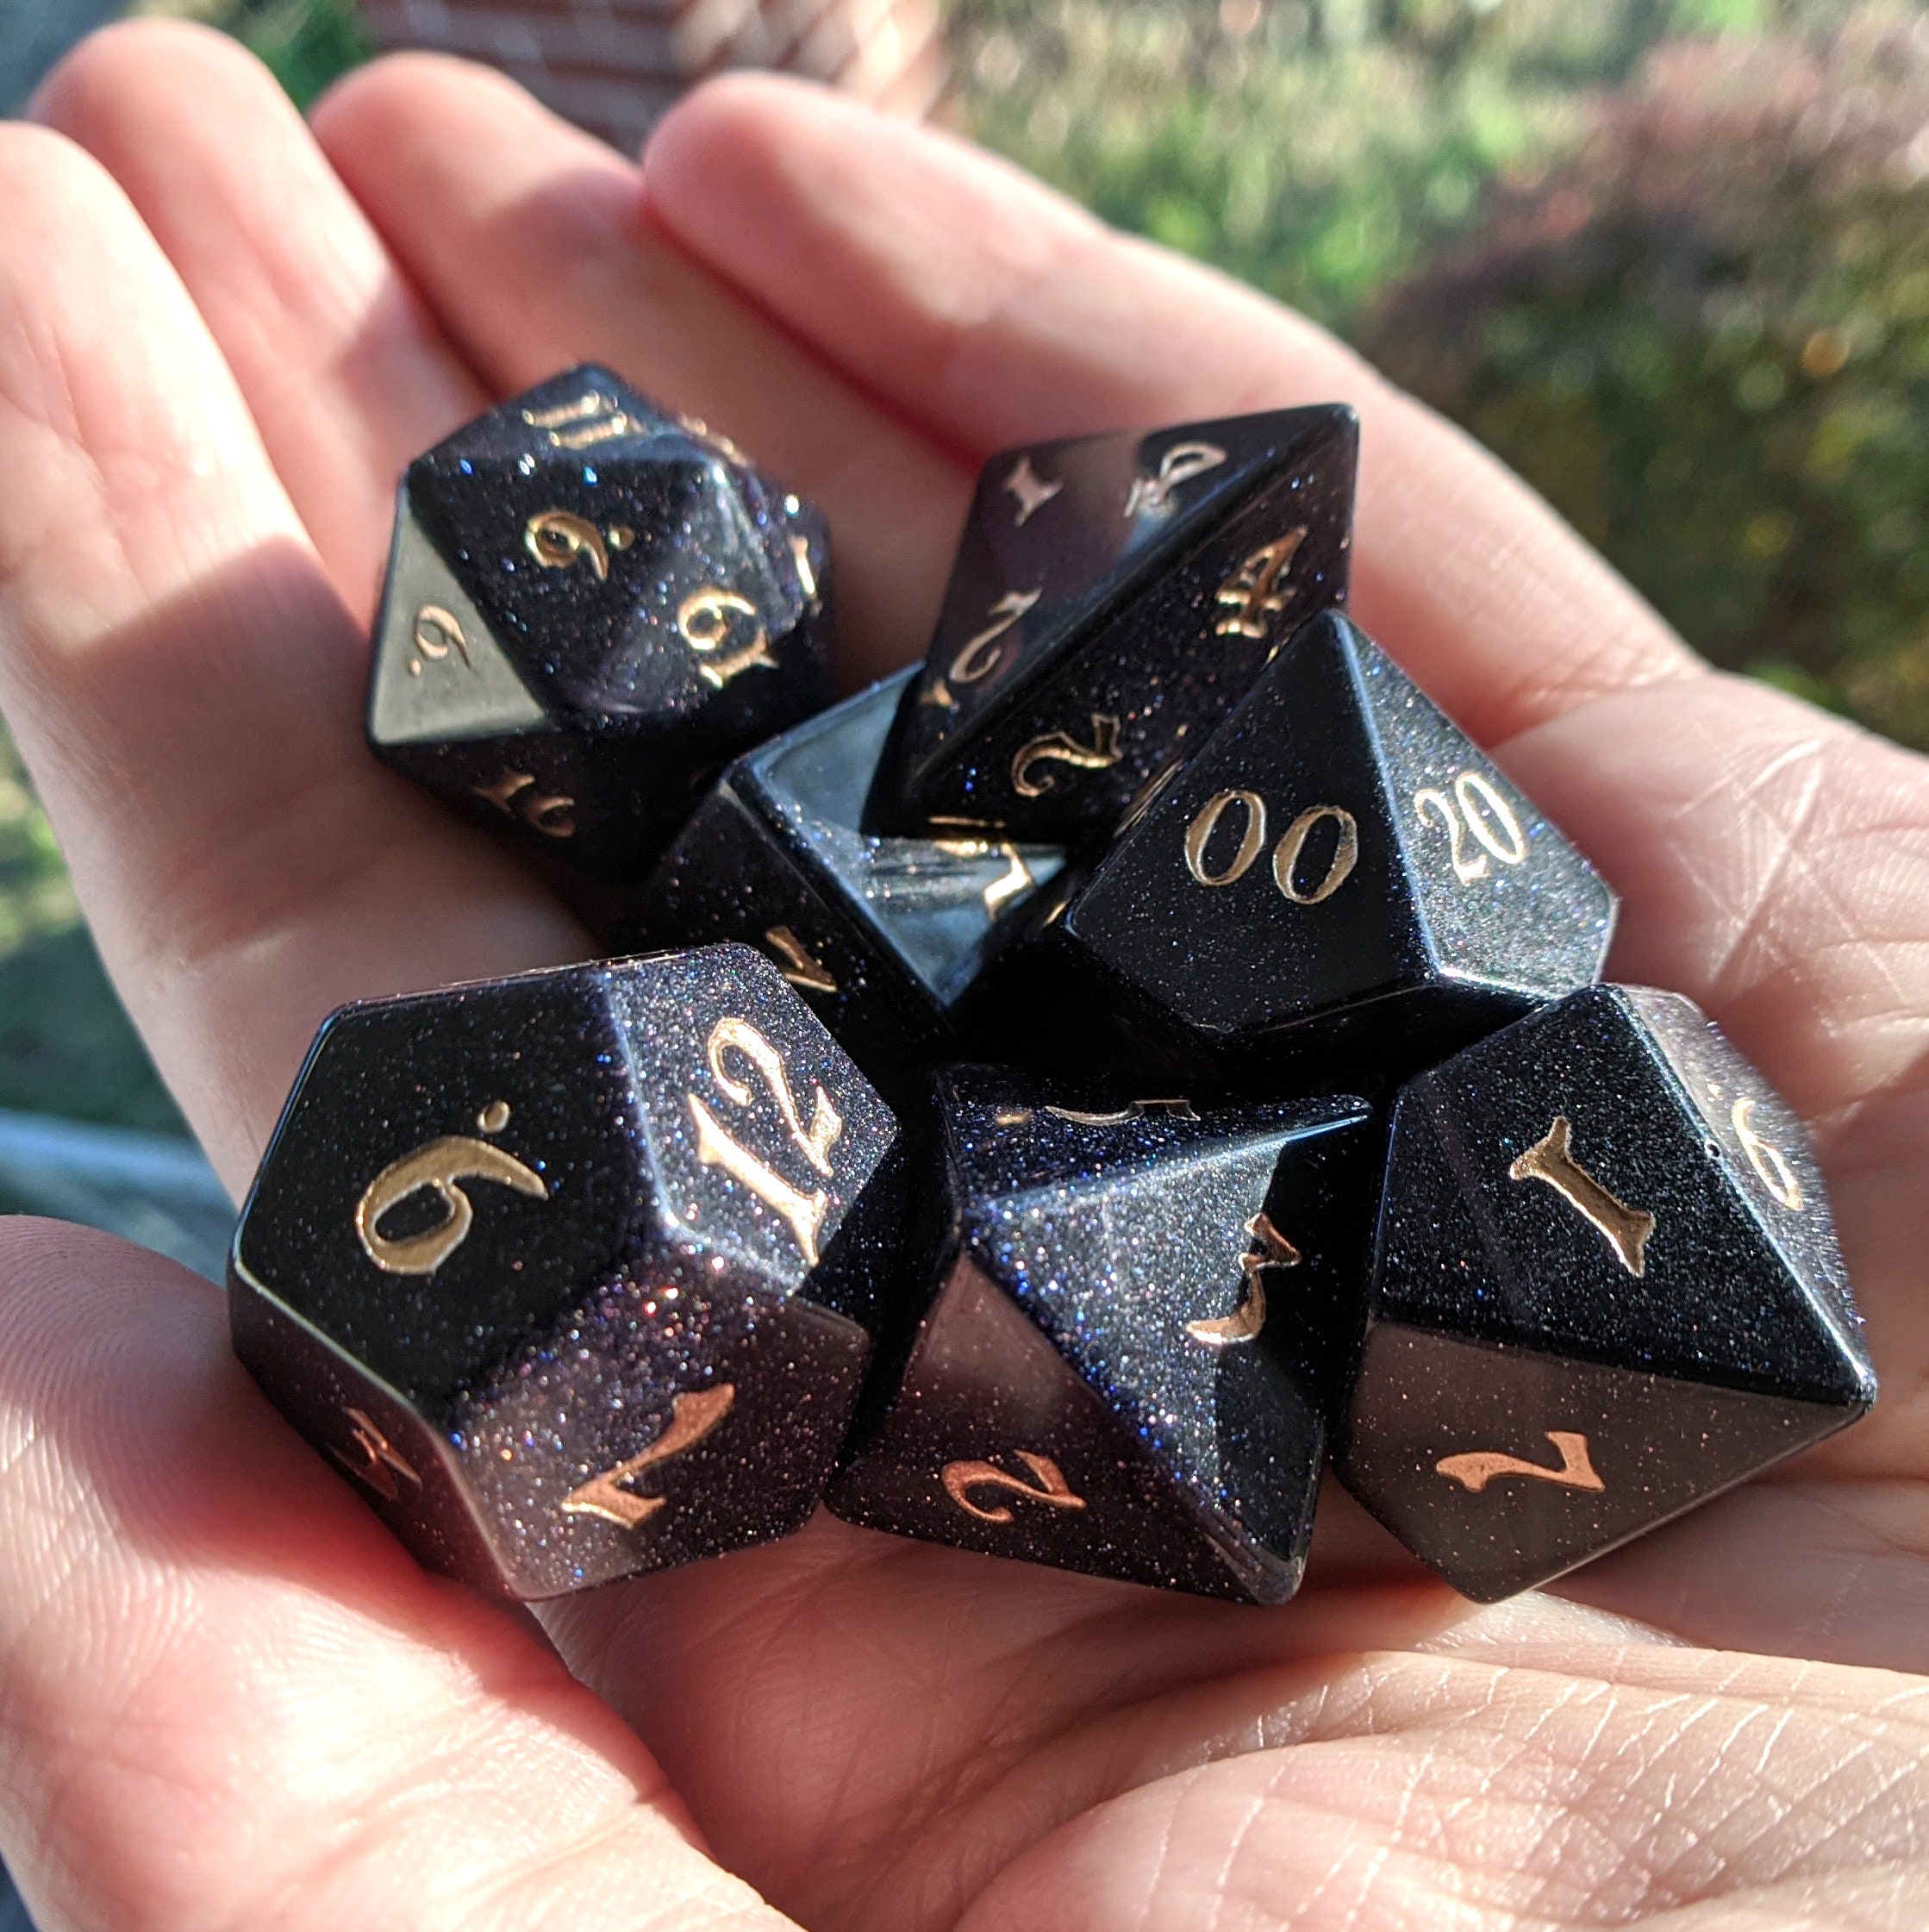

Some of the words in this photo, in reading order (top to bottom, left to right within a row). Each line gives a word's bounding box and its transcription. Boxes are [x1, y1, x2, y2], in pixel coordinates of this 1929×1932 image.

[1214, 524, 1310, 639] 4
[1010, 712, 1122, 798] 2
[1183, 788, 1360, 907] 00
[1413, 769, 1528, 885] 20
[688, 1014, 843, 1268] 12
[1509, 1116, 1657, 1279] 1
[941, 1448, 1088, 1524] 2
